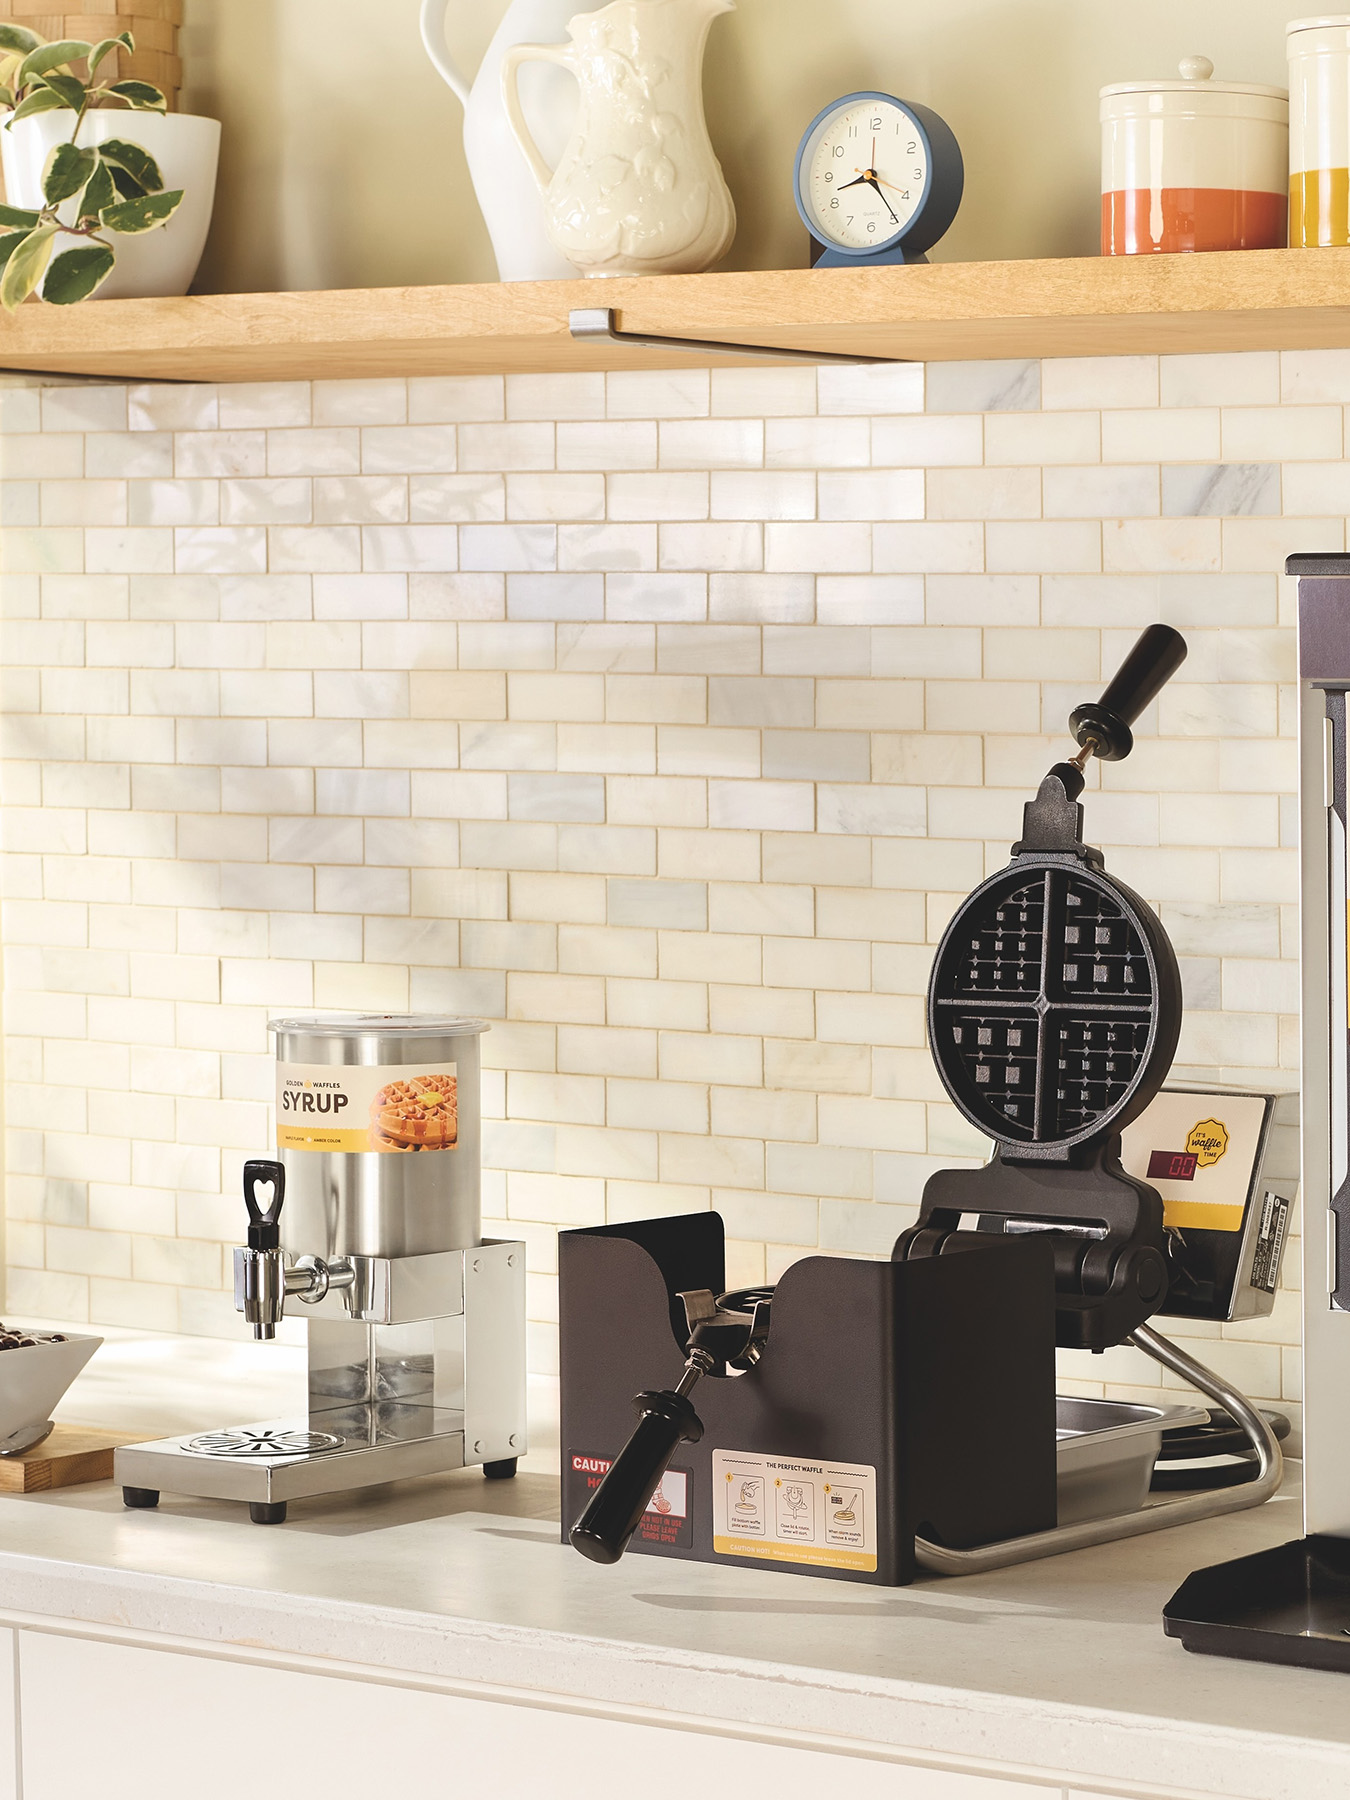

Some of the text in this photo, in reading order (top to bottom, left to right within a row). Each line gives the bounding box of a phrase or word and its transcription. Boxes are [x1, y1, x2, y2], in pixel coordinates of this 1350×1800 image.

[870, 117, 882, 130] 12
[896, 123, 899, 135] 1
[849, 126, 857, 138] 11
[832, 145, 845, 158] 10
[906, 142, 917, 154] 2
[824, 172, 833, 183] 9
[913, 168, 922, 180] 3
[901, 190, 910, 200] 4
[830, 197, 840, 209] 8
[846, 216, 854, 226] 7
[889, 214, 898, 225] 5
[866, 222, 876, 233] 6
[283, 1090, 348, 1113] SYRUP
[1191, 1138, 1222, 1151] waffle
[1169, 1156, 1195, 1176] 00
[778, 1463, 800, 1471] PERFECT
[801, 1466, 823, 1474] WAFFLE
[640, 1522, 678, 1535] PLEASE LEAVE
[661, 1534, 675, 1543] OPEN
[730, 1544, 755, 1553] CAUTION
